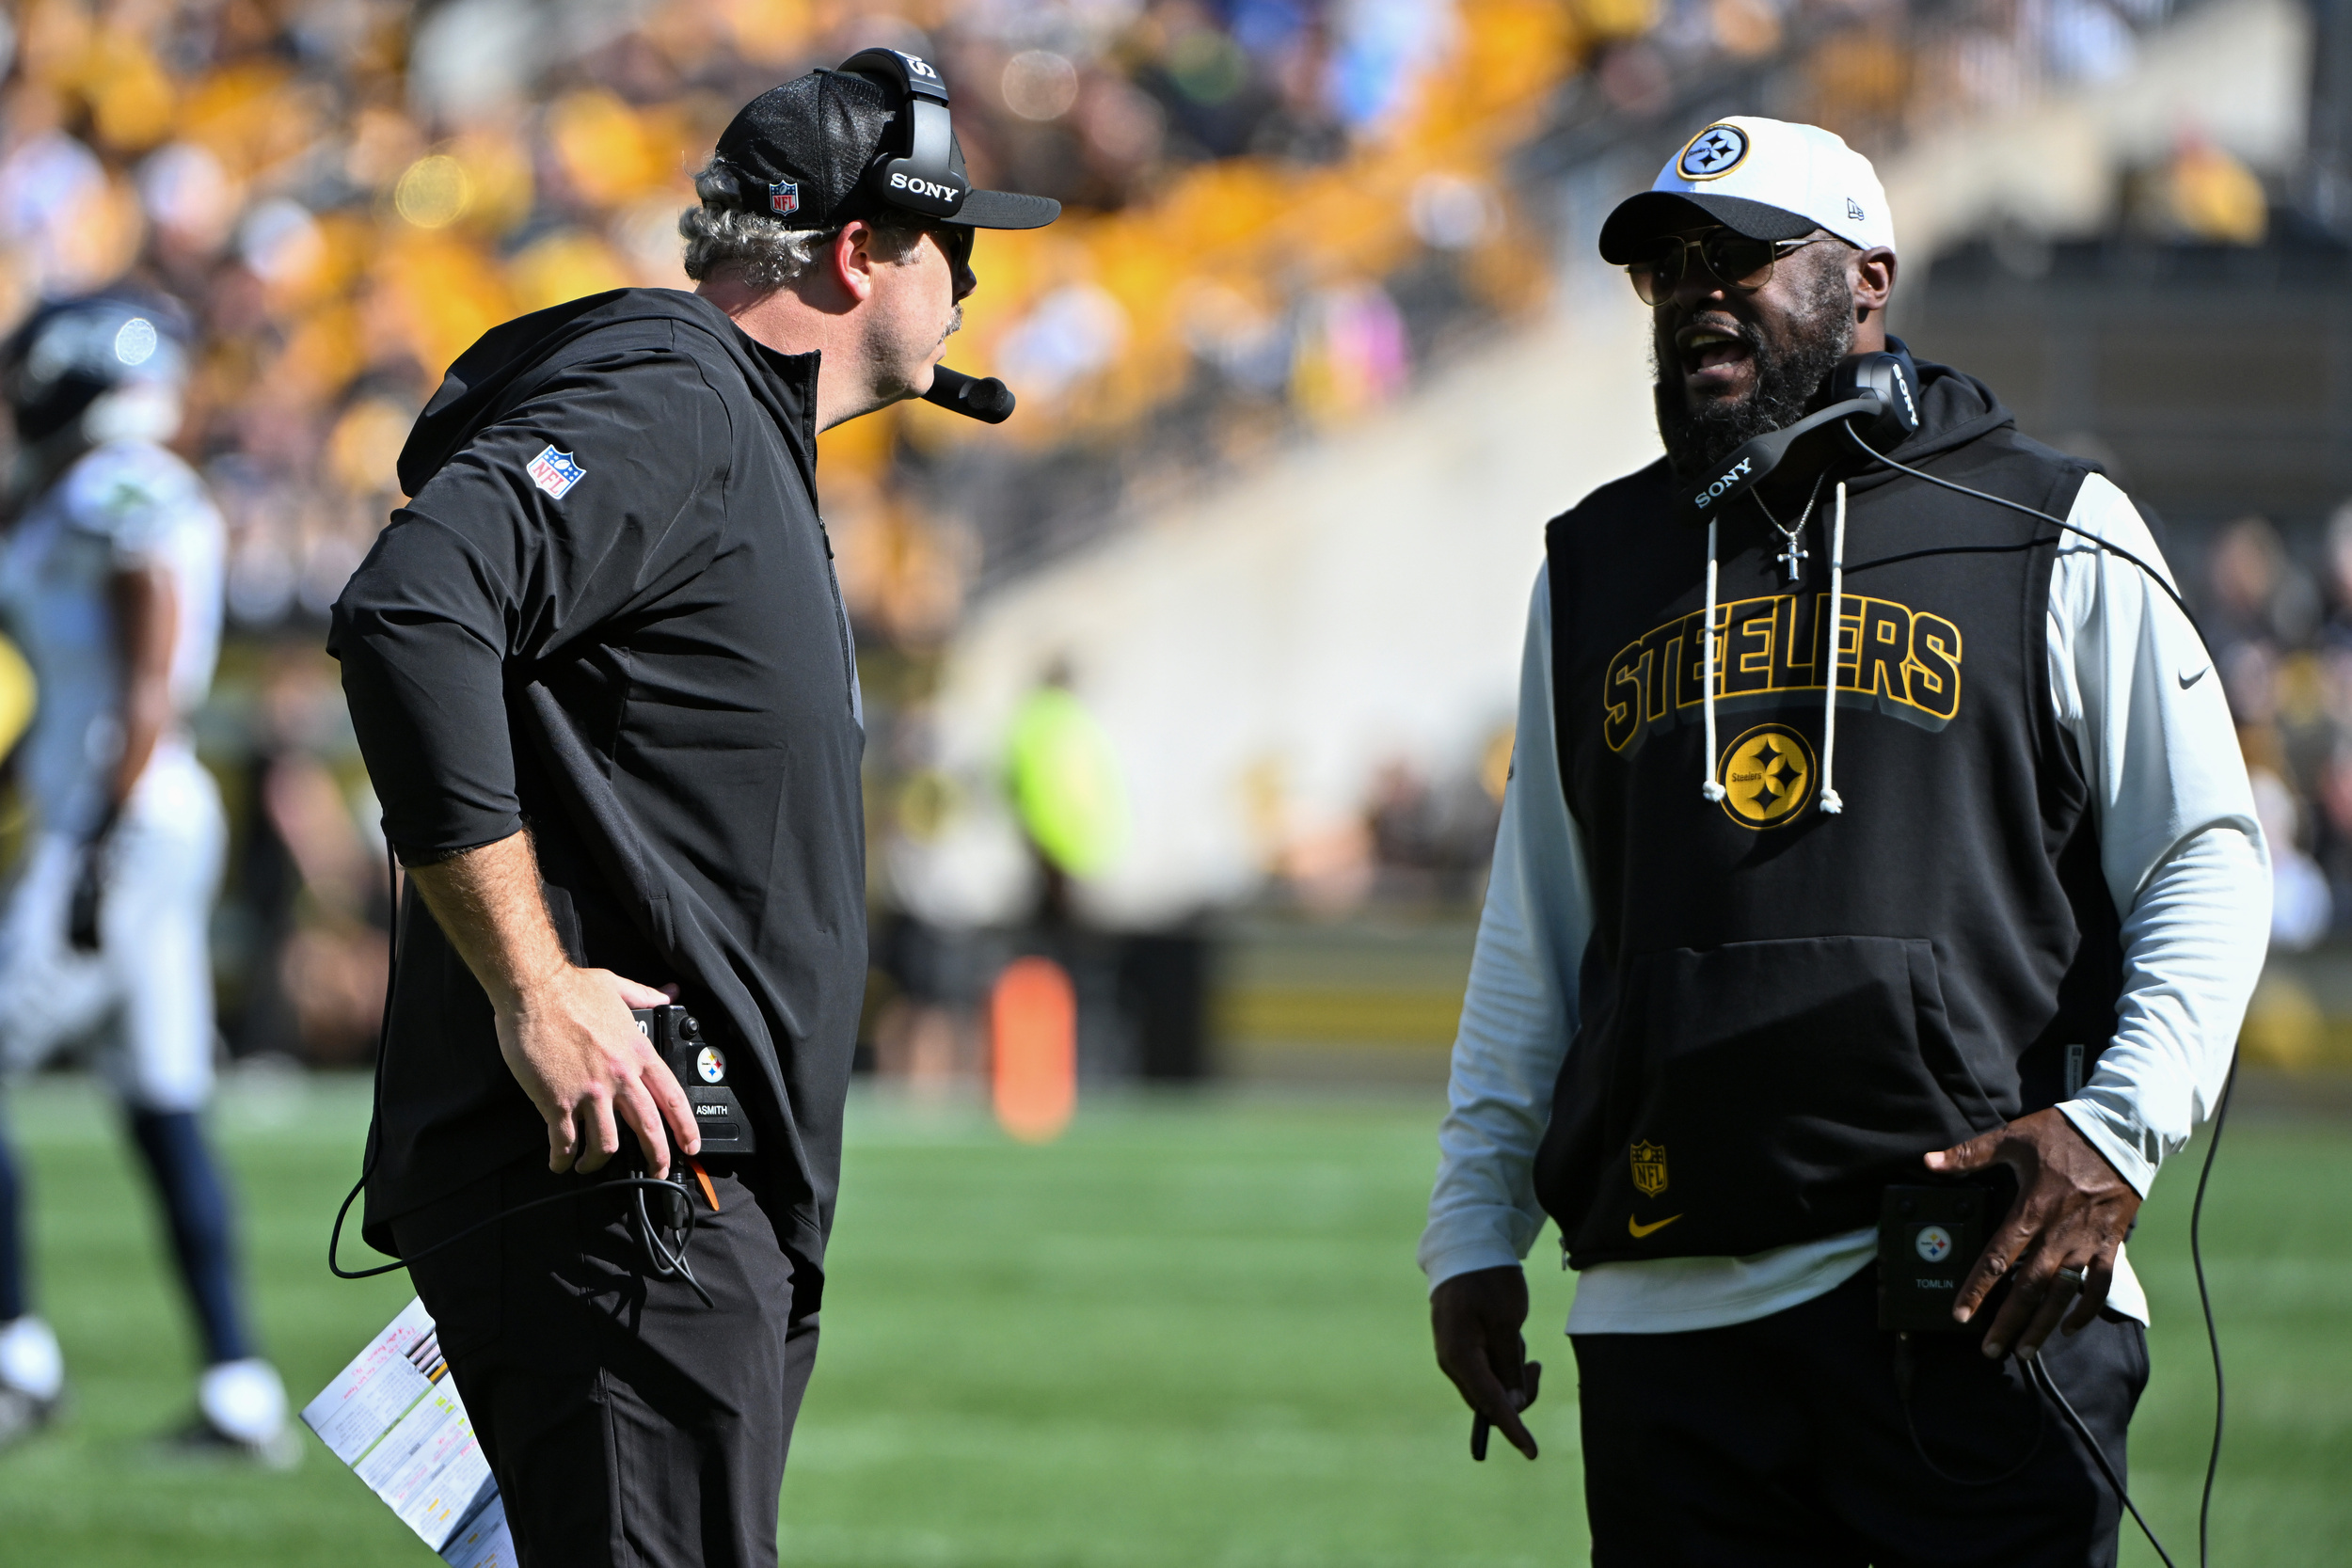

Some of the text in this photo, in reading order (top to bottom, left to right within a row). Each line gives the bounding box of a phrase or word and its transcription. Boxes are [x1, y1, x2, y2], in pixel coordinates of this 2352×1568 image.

[890, 172, 959, 202] SONY
[772, 195, 796, 212] NFL
[1892, 363, 1919, 426] SONY
[532, 461, 564, 495] NFL
[1694, 457, 1752, 509] SONY
[1603, 592, 1963, 753] STEELERS
[1731, 771, 1762, 783] Steelers
[695, 1105, 728, 1116] ASMITH
[1635, 1164, 1665, 1189] NFL
[1915, 1278, 1954, 1290] TOMLIN
